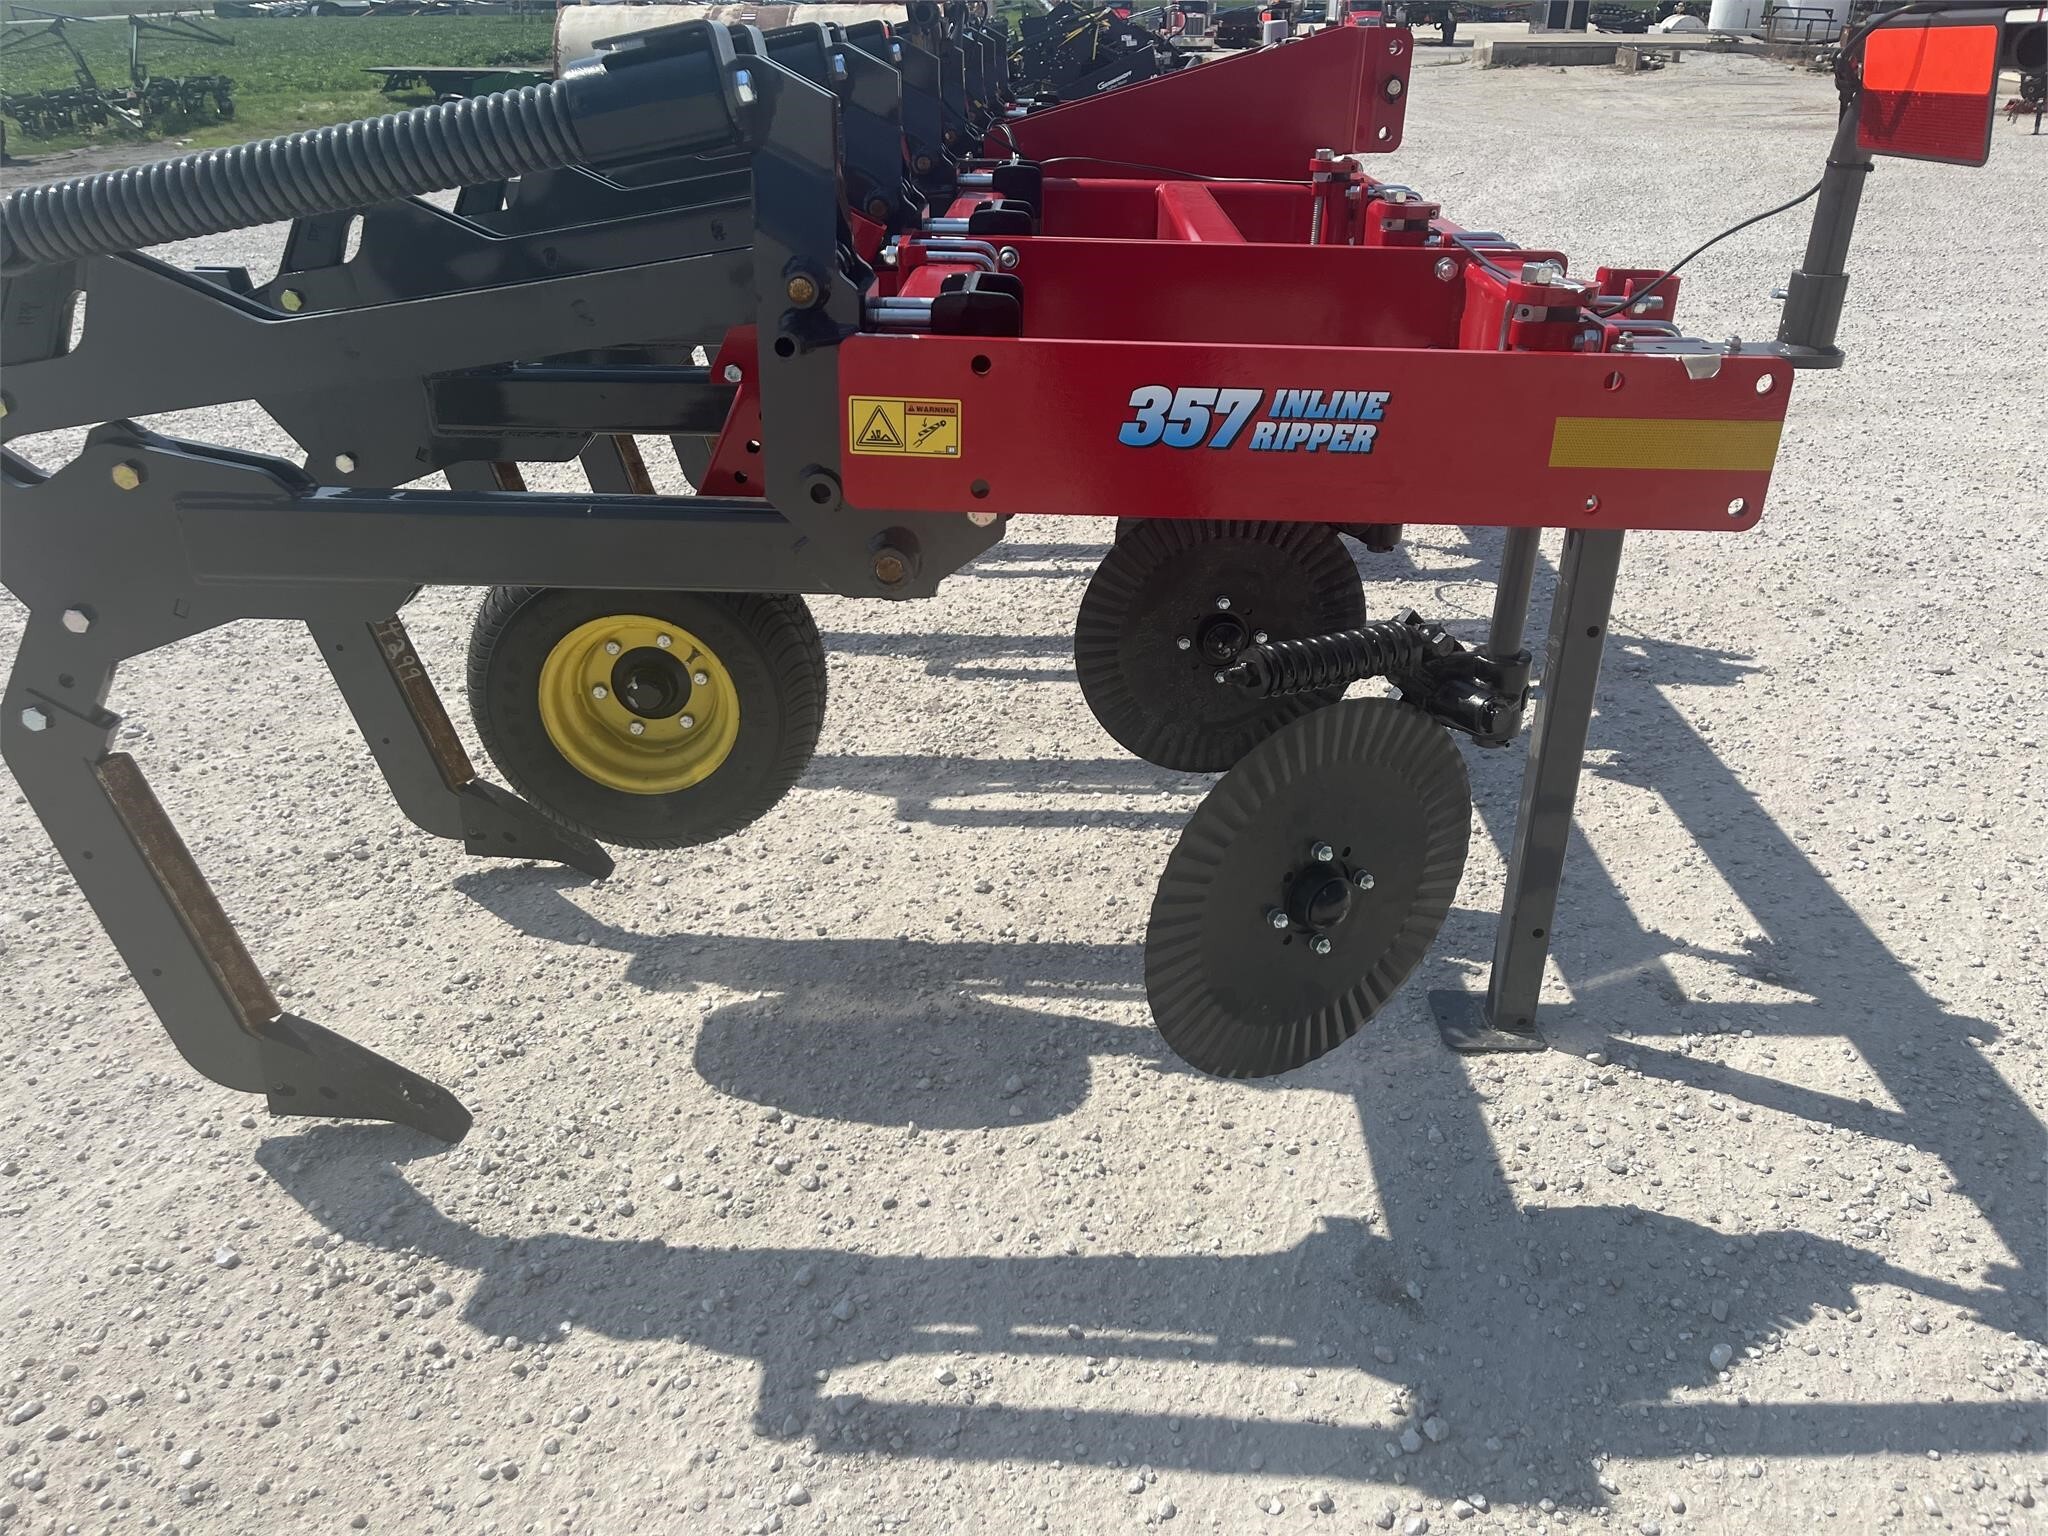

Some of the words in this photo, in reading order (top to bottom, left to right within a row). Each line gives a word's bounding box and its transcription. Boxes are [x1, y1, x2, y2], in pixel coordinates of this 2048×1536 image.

[916, 405, 956, 414] WARNING
[1118, 384, 1264, 449] 357
[1267, 388, 1391, 420] INLINE
[1248, 420, 1378, 453] RIPPER
